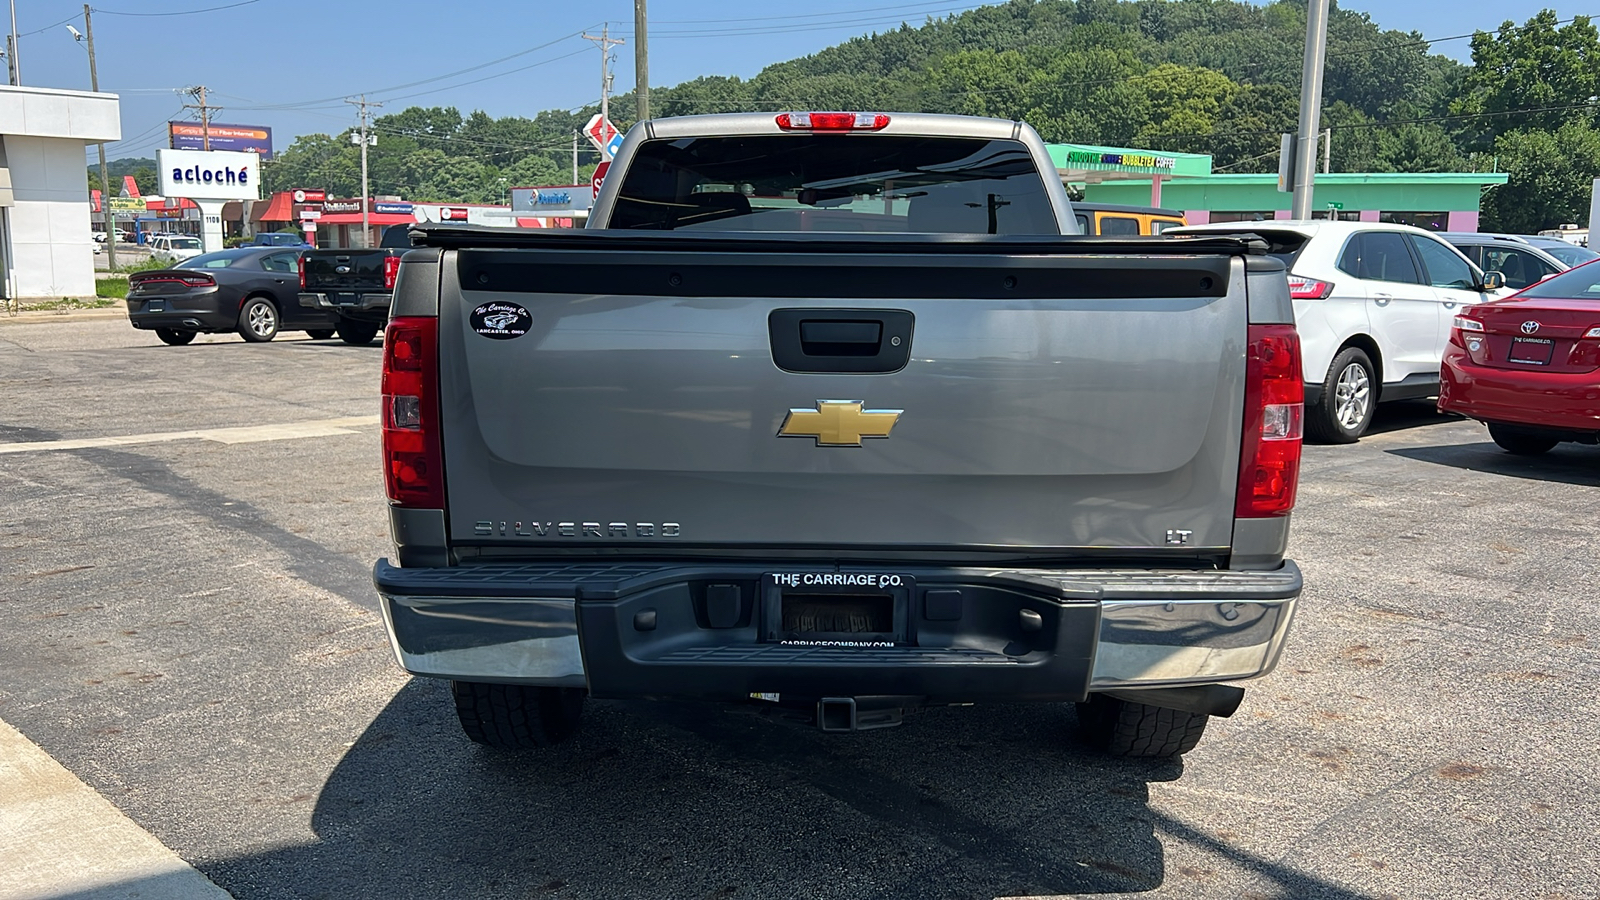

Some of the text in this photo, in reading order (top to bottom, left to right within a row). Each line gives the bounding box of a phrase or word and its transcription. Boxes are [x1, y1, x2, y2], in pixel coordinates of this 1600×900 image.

[173, 165, 248, 183] acloché
[488, 303, 516, 313] Carriage
[474, 520, 680, 537] SILVERADO
[1166, 529, 1193, 544] LT
[772, 573, 904, 587] THE CARRIAGE CO.
